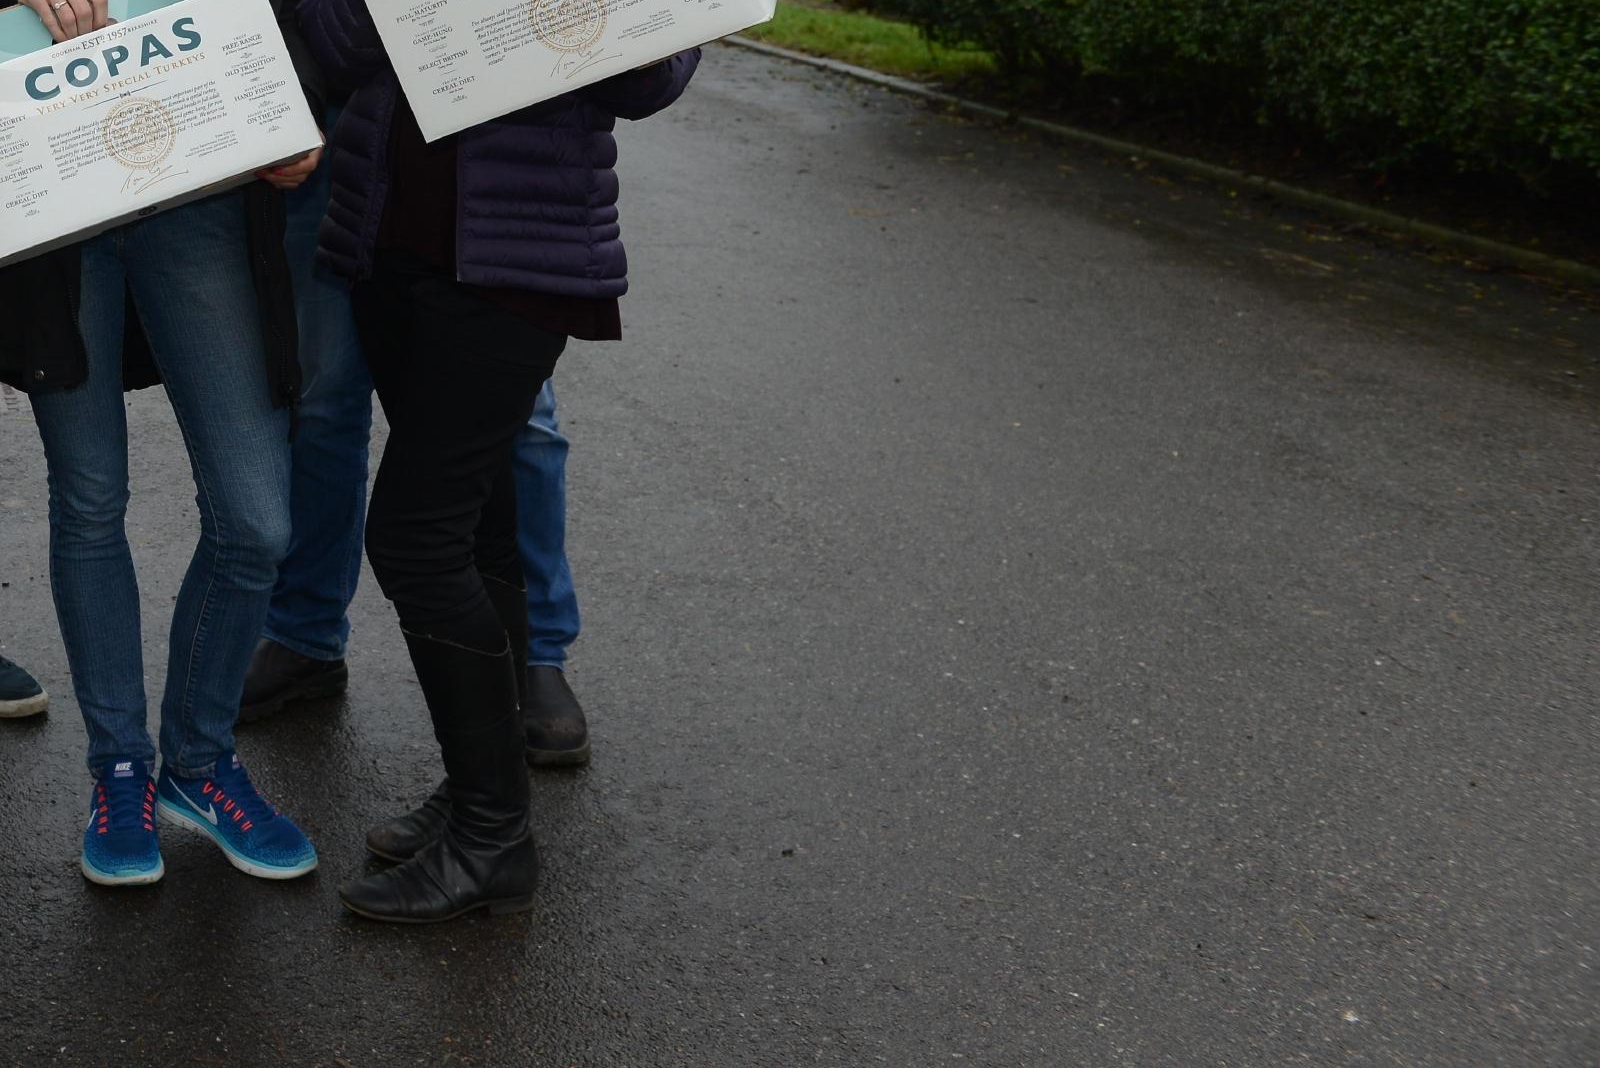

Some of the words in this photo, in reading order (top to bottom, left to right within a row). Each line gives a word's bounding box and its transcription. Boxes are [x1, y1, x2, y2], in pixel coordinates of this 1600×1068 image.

[396, 13, 414, 23] FULL
[414, 0, 447, 16] MATURITY
[107, 27, 126, 41] 1957
[413, 26, 453, 45] GAME-HUNG
[24, 17, 202, 101] COPAS
[418, 59, 442, 72] SELECT
[442, 50, 468, 63] BRITISH
[432, 82, 458, 95] CEREAL
[459, 75, 475, 86] DIET
[115, 762, 132, 771] NIKE
